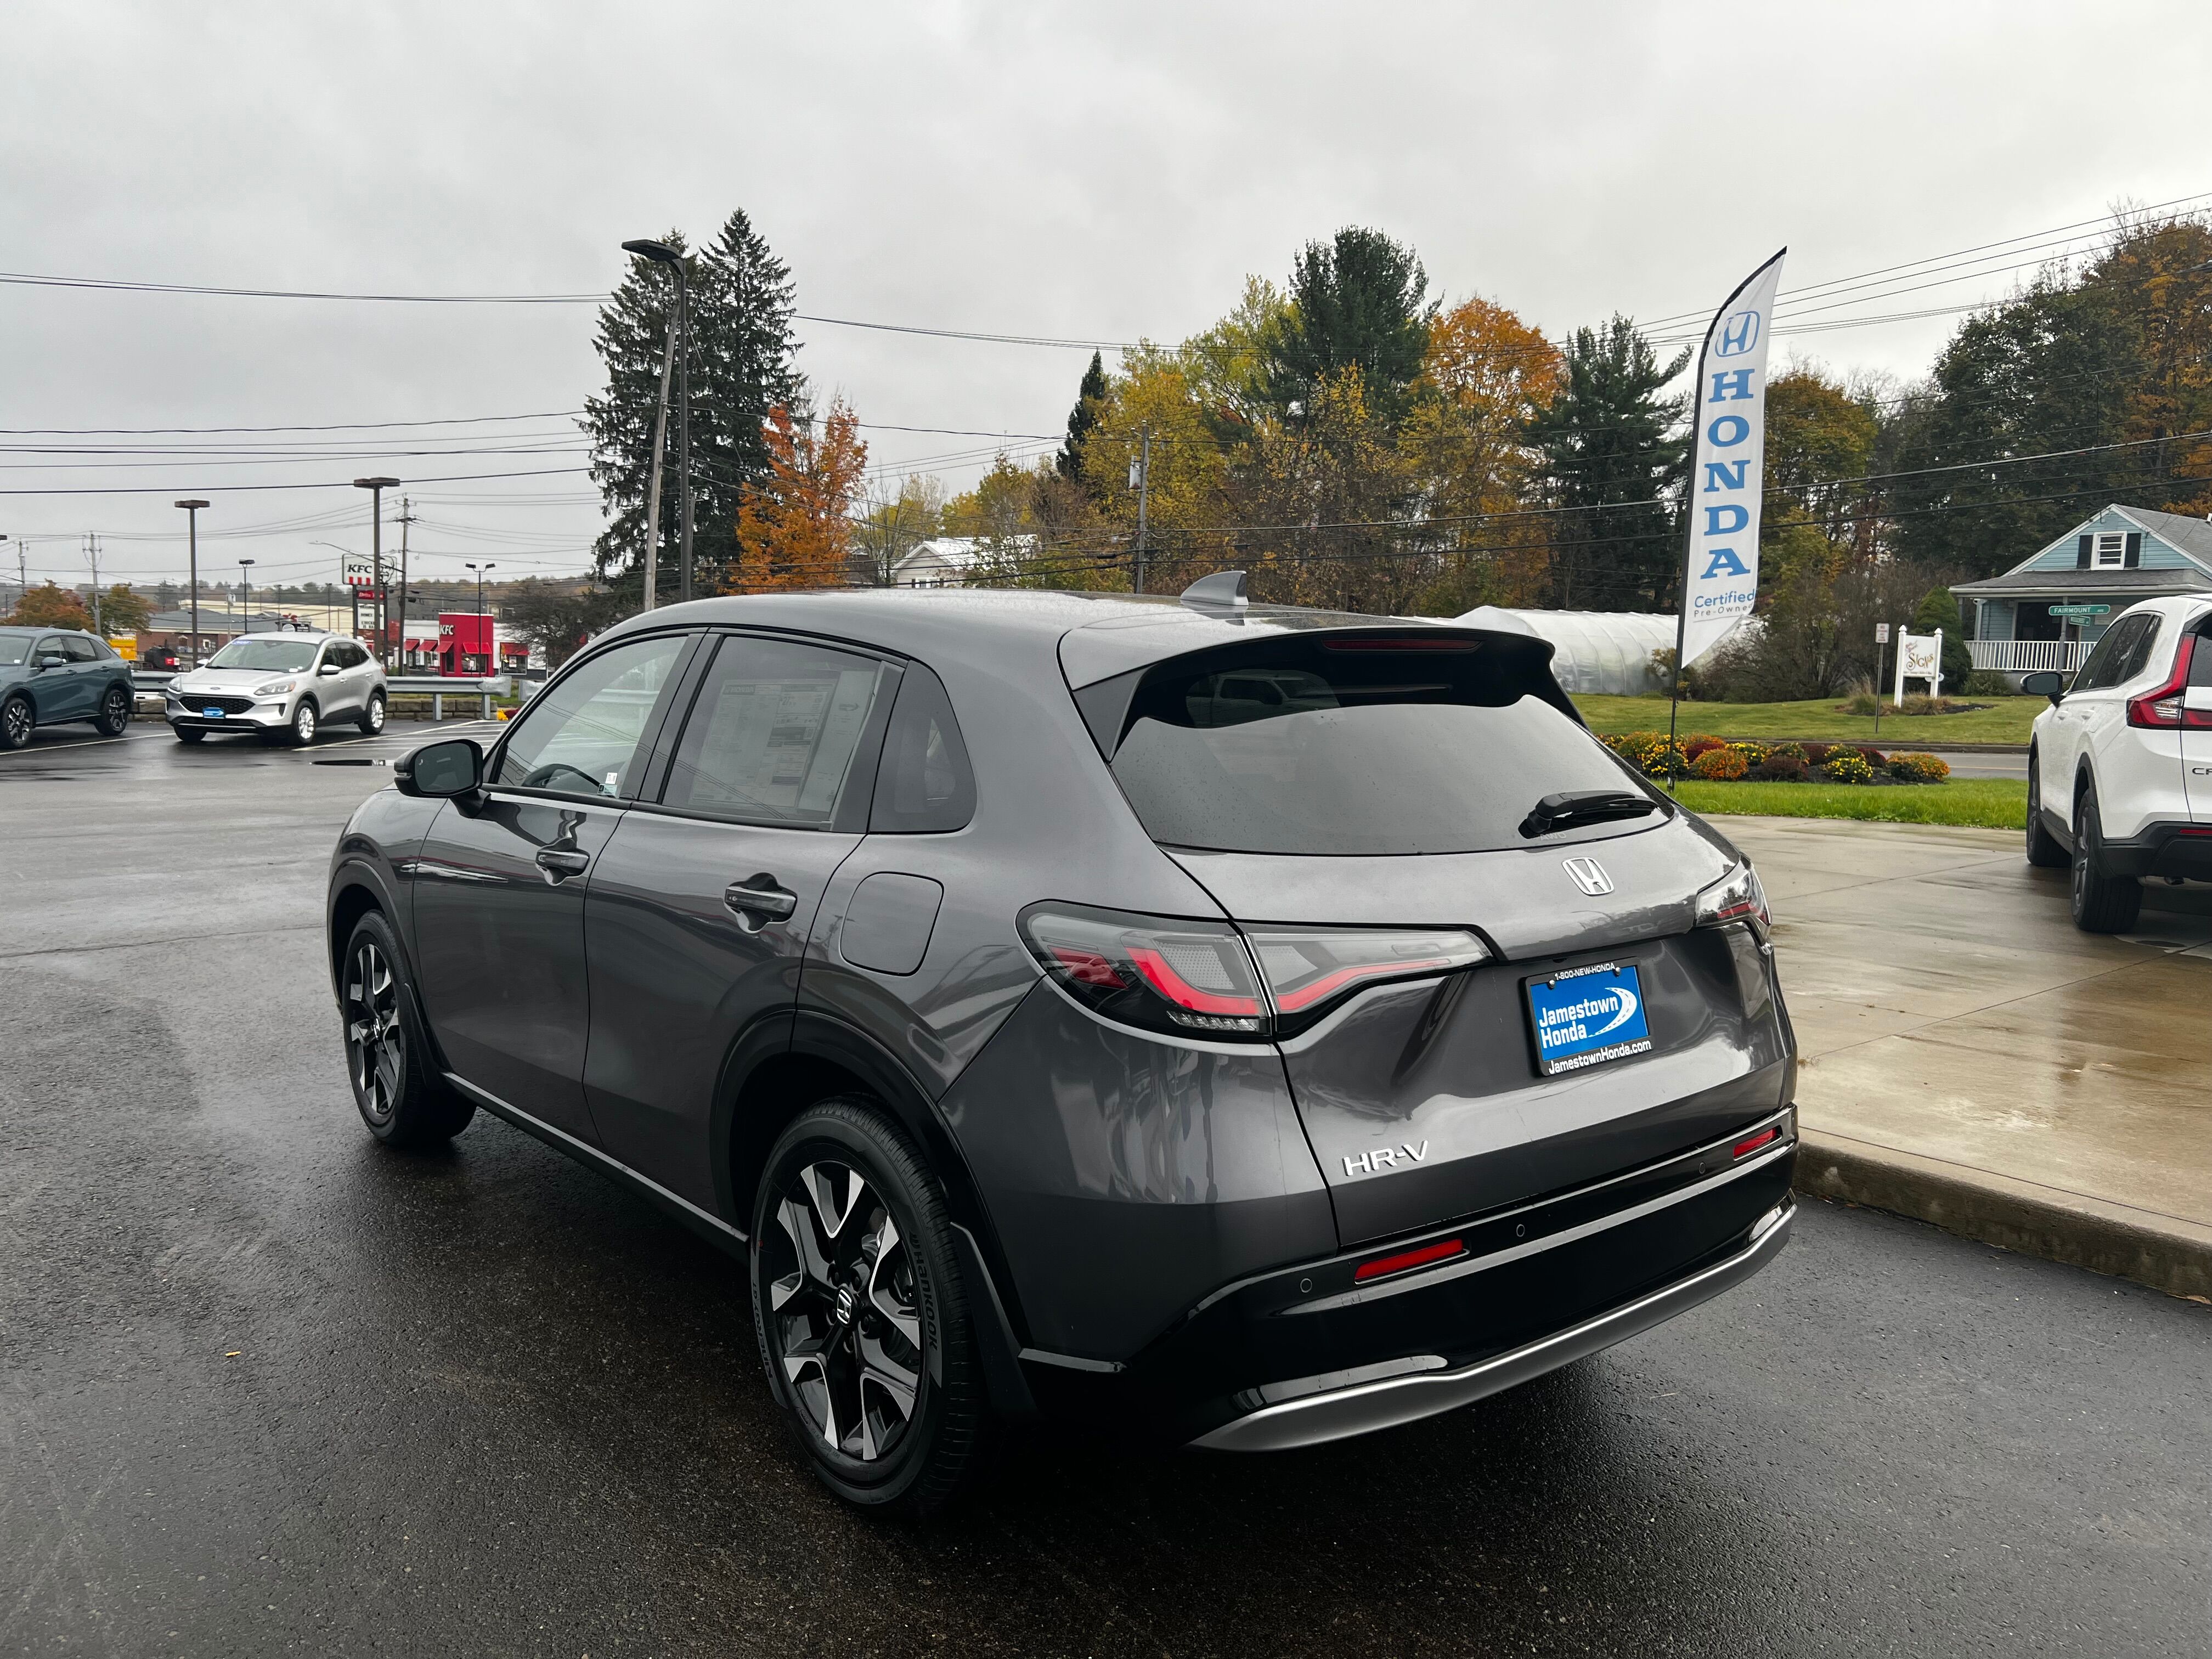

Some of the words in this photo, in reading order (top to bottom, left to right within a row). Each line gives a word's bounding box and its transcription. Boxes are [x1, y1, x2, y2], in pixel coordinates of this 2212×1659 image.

[1701, 369, 1755, 580] HONDA
[347, 565, 372, 573] KFC
[1695, 588, 1754, 608] Certified
[1694, 602, 1753, 617] Pre-Owned
[439, 624, 454, 635] KFC
[1541, 832, 1566, 840] AWD
[1555, 962, 1616, 980] 1-800-NEW-HONDA
[1539, 996, 1618, 1028] Jamestown
[1540, 1020, 1587, 1048] Honda
[1548, 1040, 1651, 1074] JamestownHonda.com
[1342, 1140, 1428, 1176] HR-V
